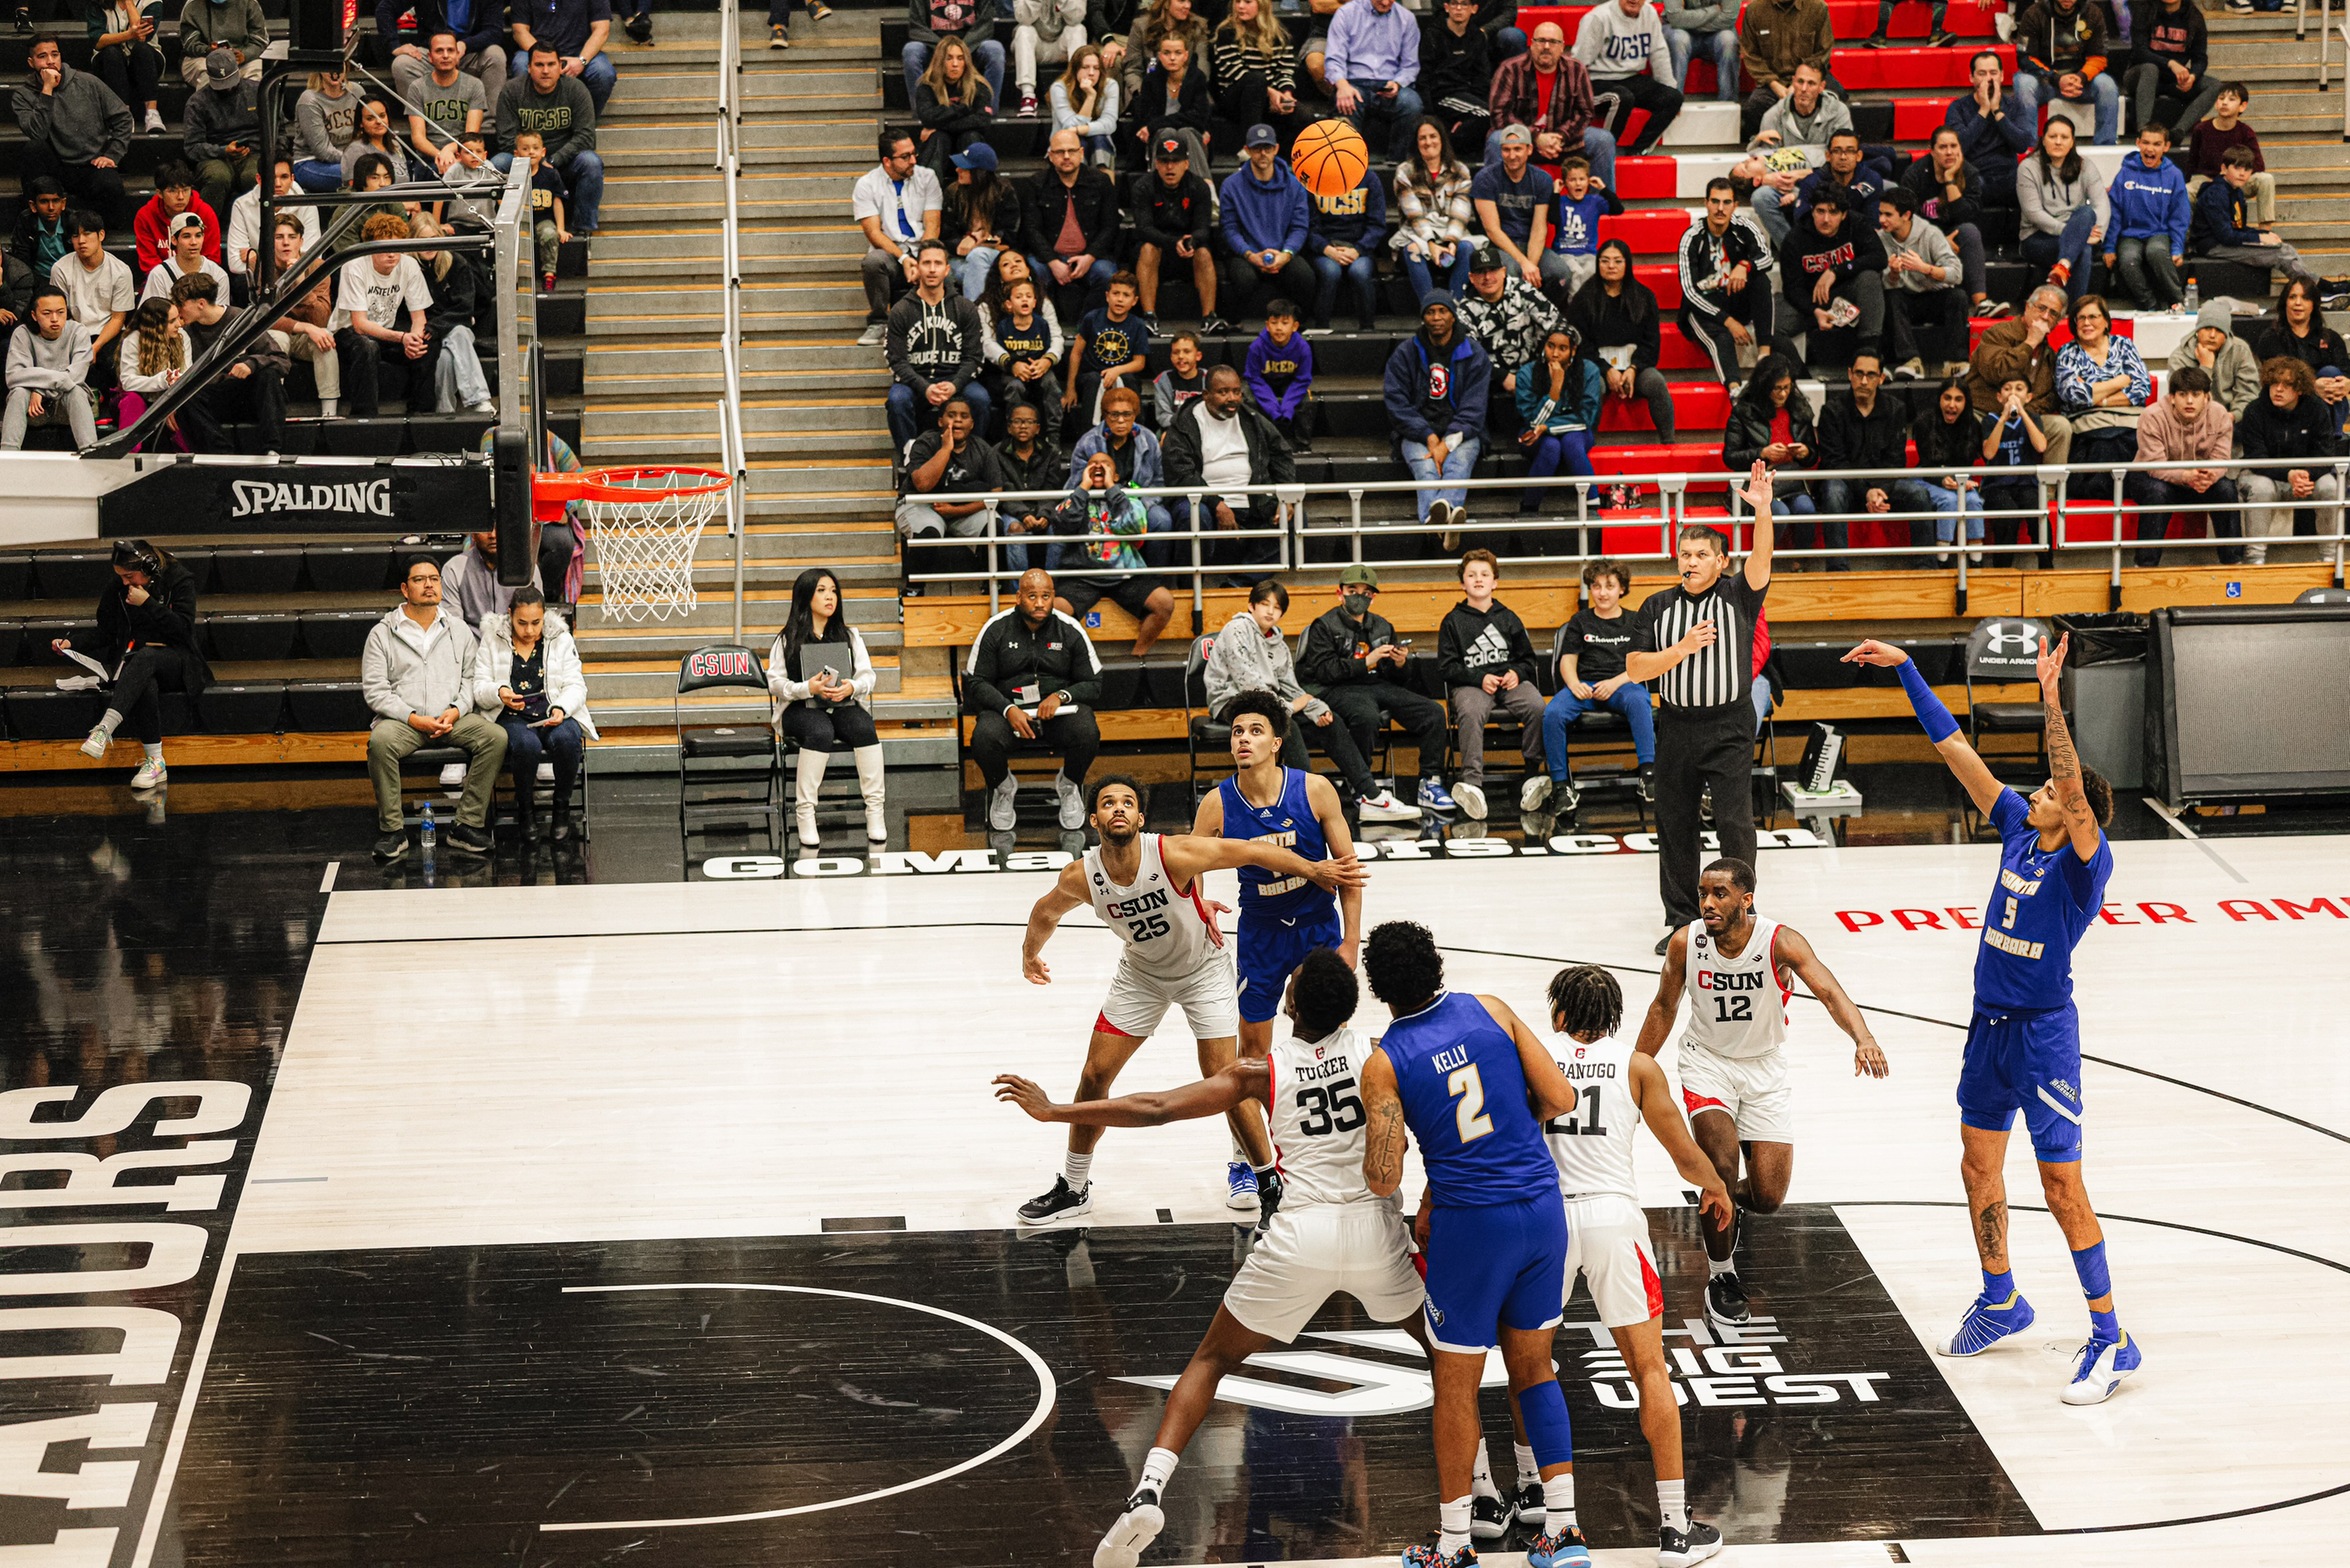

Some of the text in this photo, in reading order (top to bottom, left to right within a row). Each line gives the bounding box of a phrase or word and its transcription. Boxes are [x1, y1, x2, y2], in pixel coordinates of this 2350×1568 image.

[325, 108, 356, 132] UCS
[518, 106, 572, 131] UCSB
[1563, 206, 1587, 240] LA
[1802, 243, 1854, 273] CSUN
[941, 350, 962, 364] LEE
[232, 478, 391, 517] SPALDING
[1584, 634, 1631, 646] Champio
[690, 652, 749, 677] CSUN
[1979, 656, 2008, 665] UNDER
[2001, 868, 2042, 897] SANTA
[1106, 887, 1170, 919] CSUN
[1834, 896, 2350, 933] PREER AM
[2001, 896, 2019, 930] 5
[1127, 912, 1171, 942] 25
[1983, 925, 2045, 960] BARBARA
[1697, 969, 1765, 991] CSUN
[1713, 995, 1762, 1022] 12
[1295, 1055, 1350, 1083] TUCKER
[1431, 1043, 1469, 1075] KELLY
[1556, 1060, 1617, 1080] BANUGO
[1296, 1076, 1367, 1137] 35
[1447, 1062, 1495, 1144] 2
